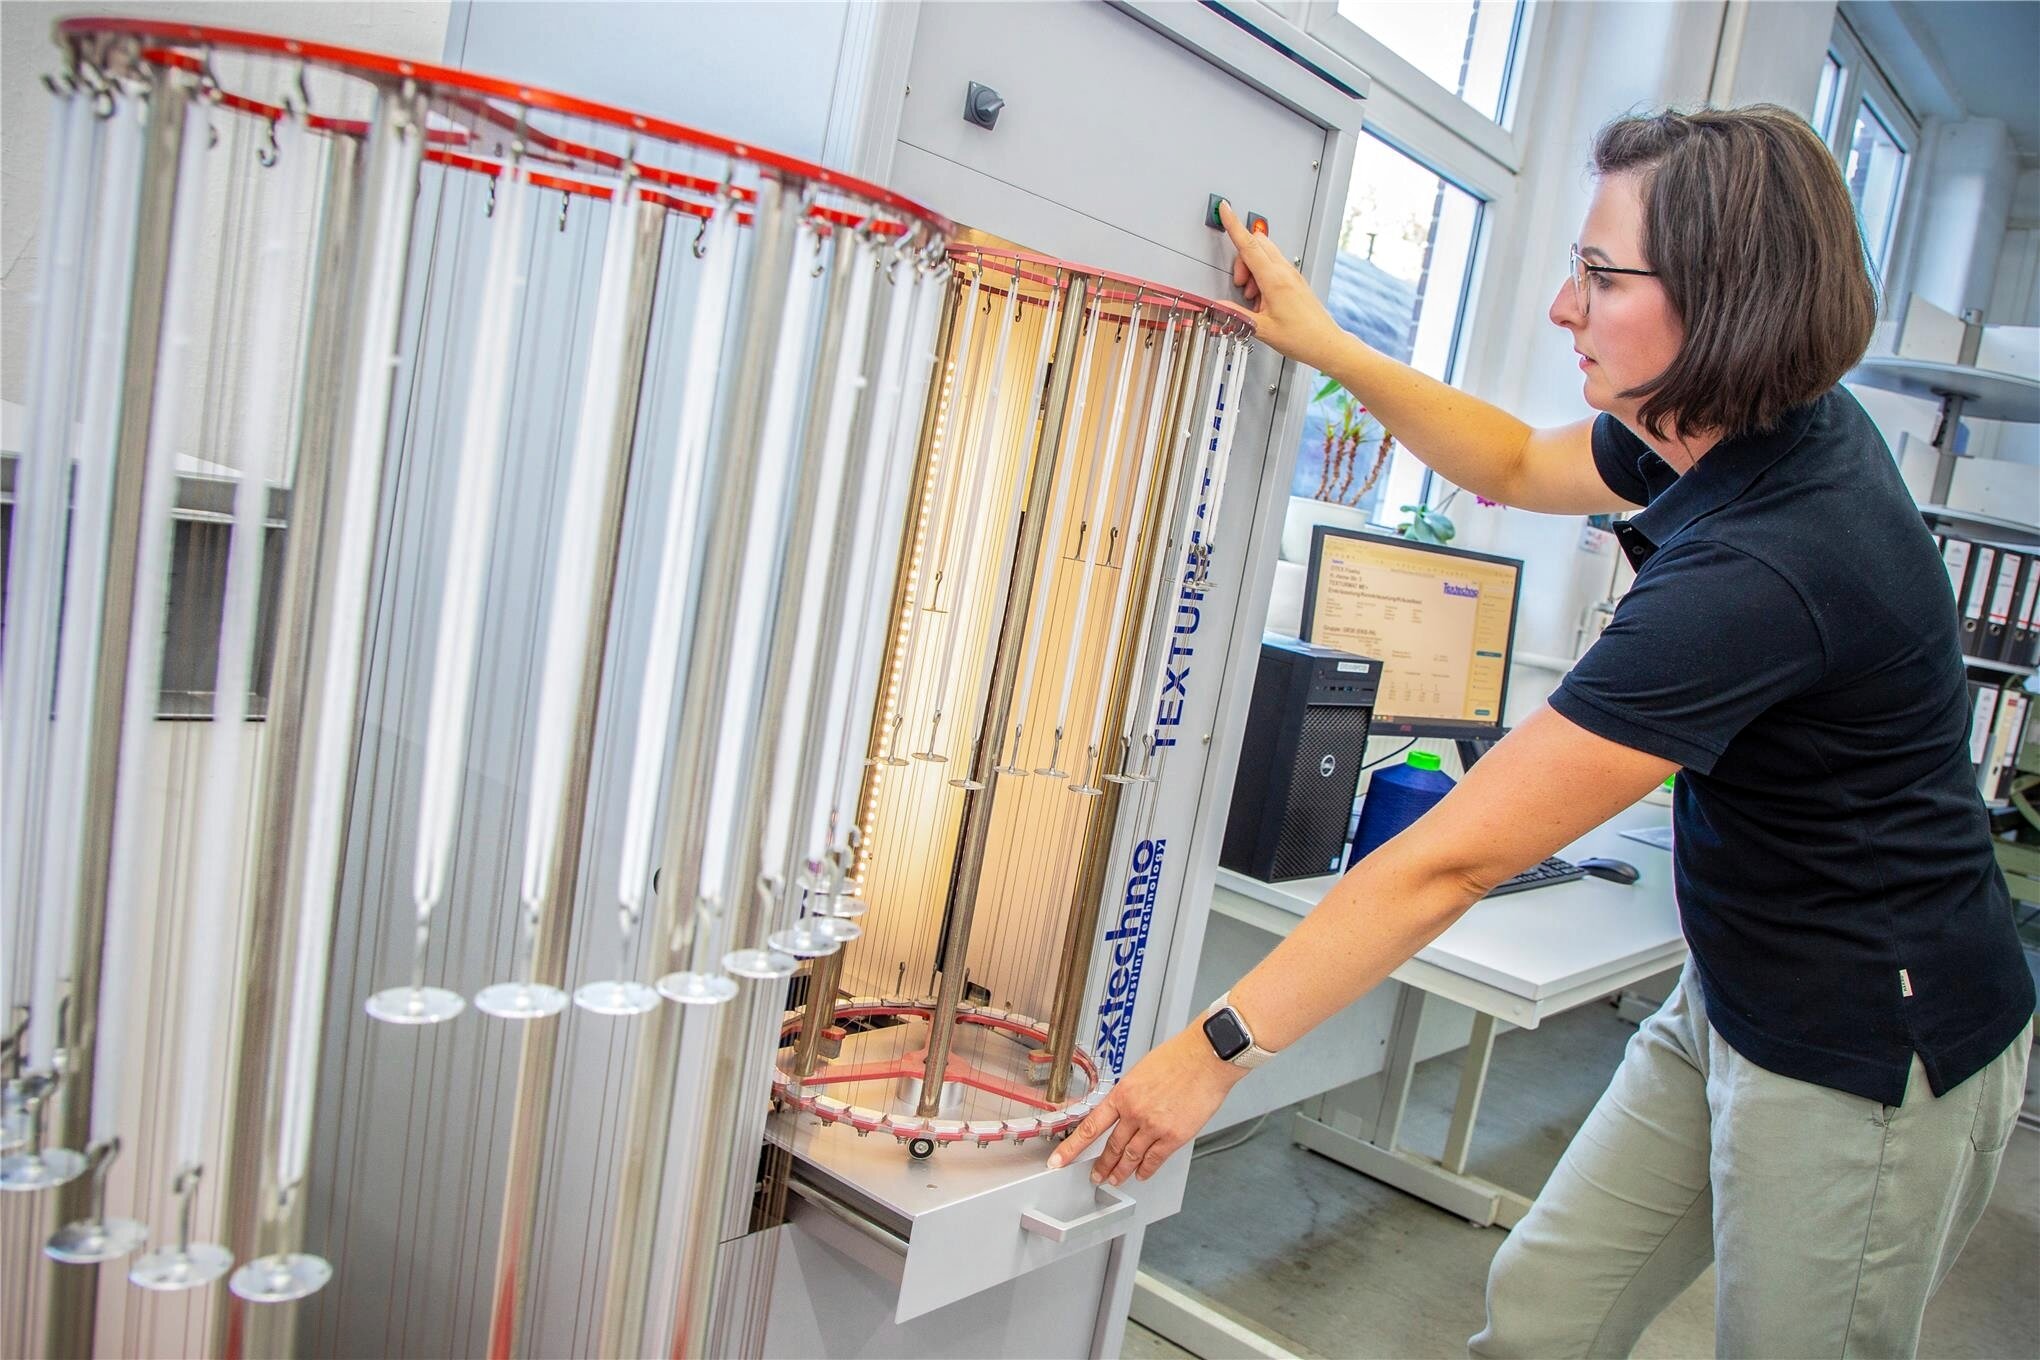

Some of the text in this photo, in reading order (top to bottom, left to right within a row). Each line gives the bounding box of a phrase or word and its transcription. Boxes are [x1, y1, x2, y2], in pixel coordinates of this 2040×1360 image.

[1150, 458, 1214, 757] TEXTUR
[1098, 839, 1154, 1084] xtechno
[1113, 841, 1166, 1072] textile testing technology
